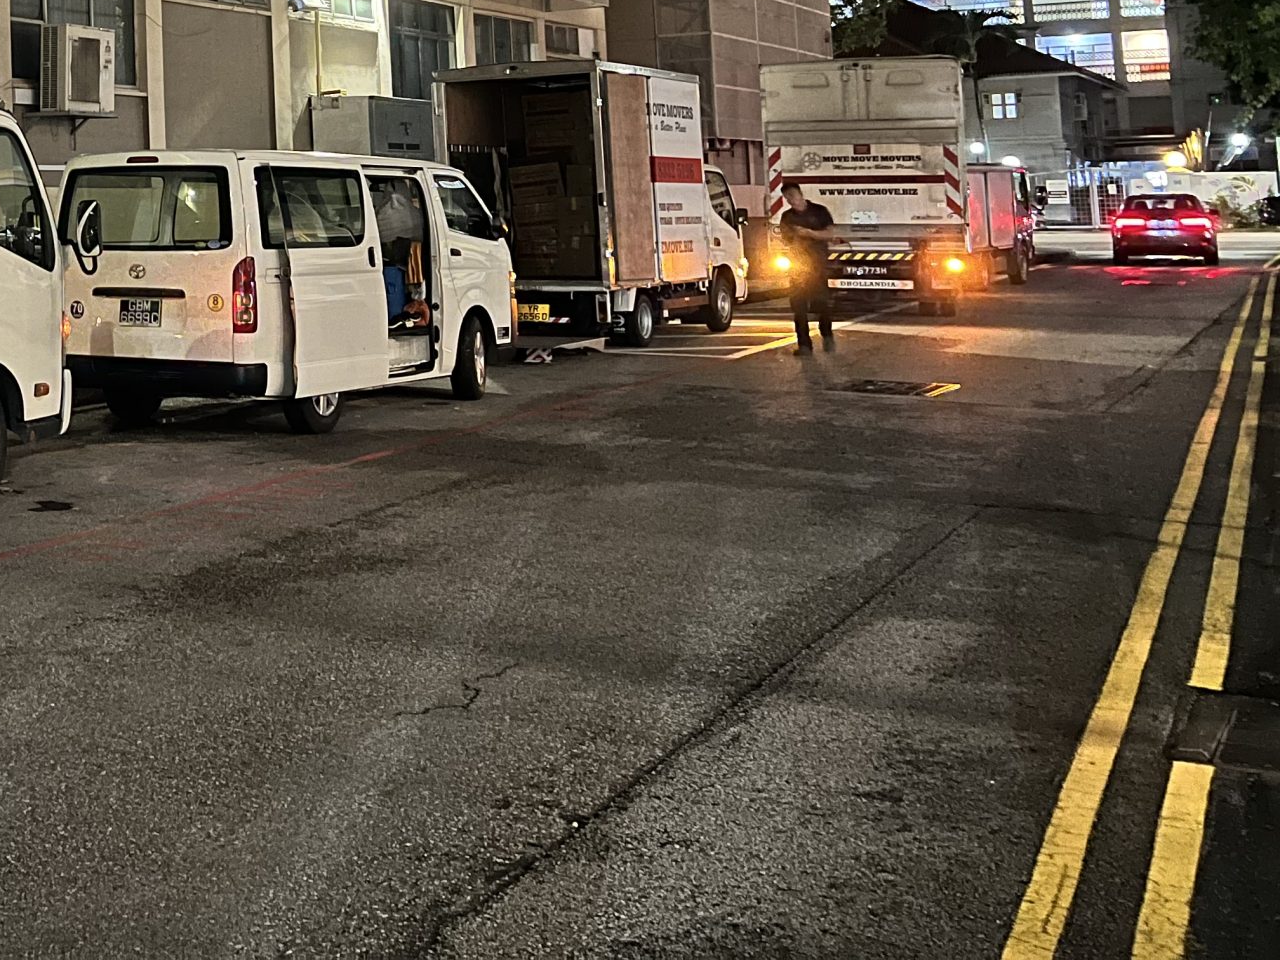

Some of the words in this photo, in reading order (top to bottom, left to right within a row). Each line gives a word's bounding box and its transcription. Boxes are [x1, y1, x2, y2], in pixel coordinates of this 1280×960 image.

[822, 155, 850, 163] MOVE
[128, 300, 151, 312] GBM
[212, 295, 219, 306] 8
[72, 302, 83, 313] 70
[120, 311, 159, 324] 6699C
